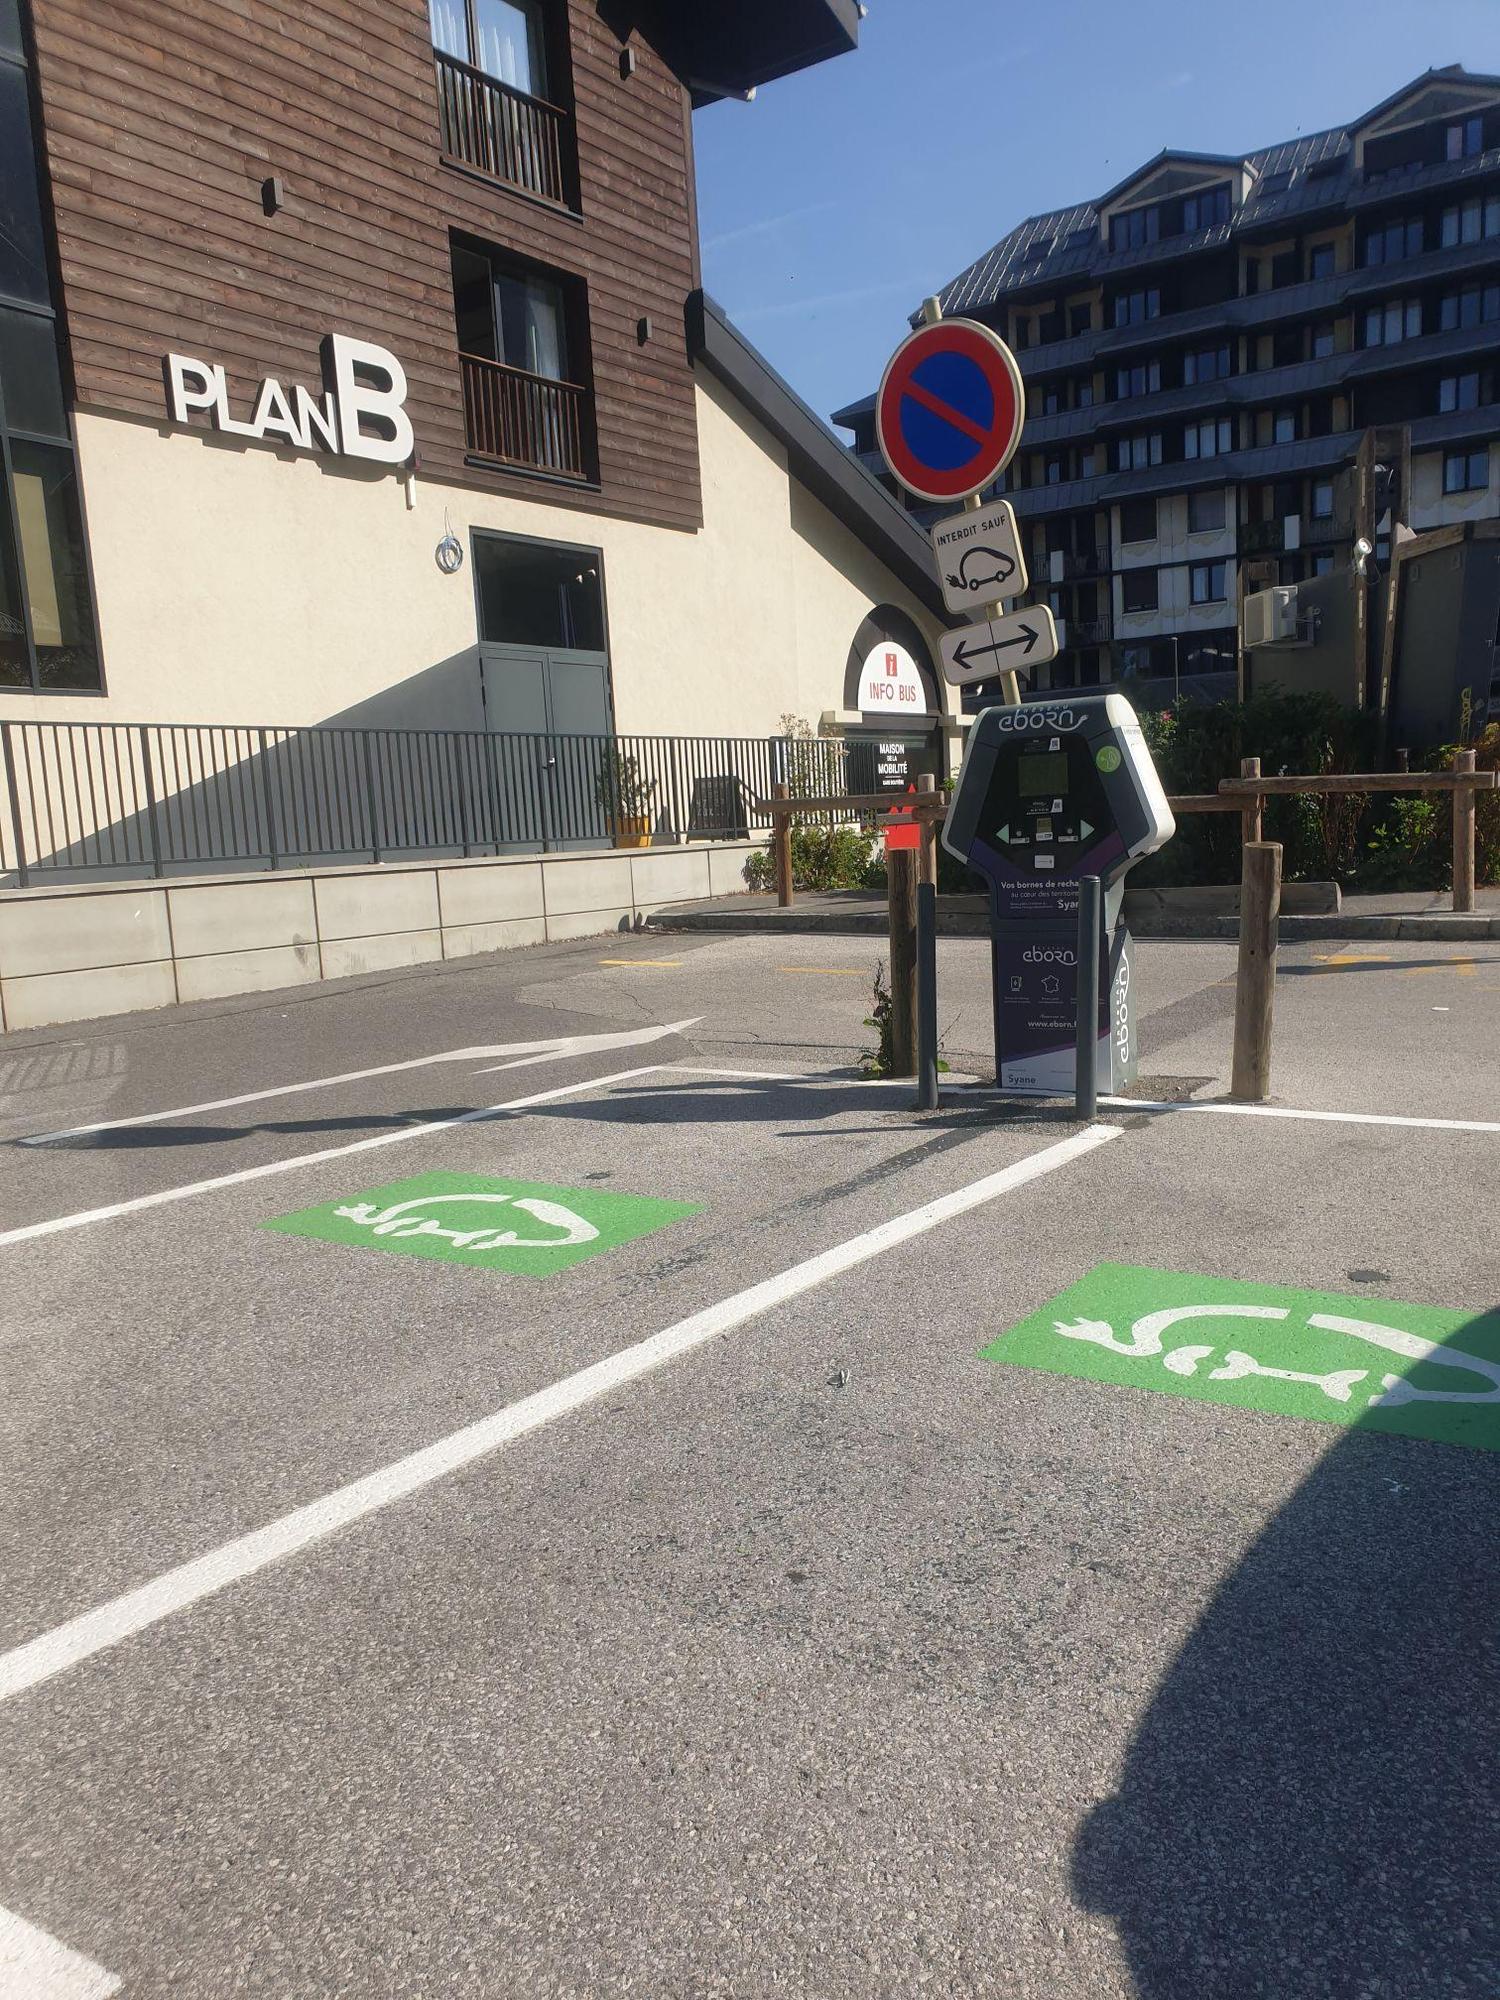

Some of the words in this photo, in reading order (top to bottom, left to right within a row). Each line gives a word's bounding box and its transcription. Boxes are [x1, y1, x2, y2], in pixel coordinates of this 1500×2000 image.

[937, 525, 977, 546] INTERDIT
[981, 515, 1006, 532] SAUF
[869, 682, 895, 700] INFO
[899, 684, 917, 702] BUS
[998, 708, 1088, 732] eborn
[879, 743, 905, 755] MAISON
[877, 760, 908, 774] MOBILITÉ
[1000, 881, 1015, 889] Vos
[1016, 880, 1043, 889] bornes
[1045, 880, 1056, 888] de
[1057, 879, 1079, 888] recha
[1022, 945, 1078, 966] eborn
[1116, 948, 1130, 1063] eborn
[1027, 1020, 1077, 1029] www.eborn.f
[1008, 1074, 1036, 1085] Syane
